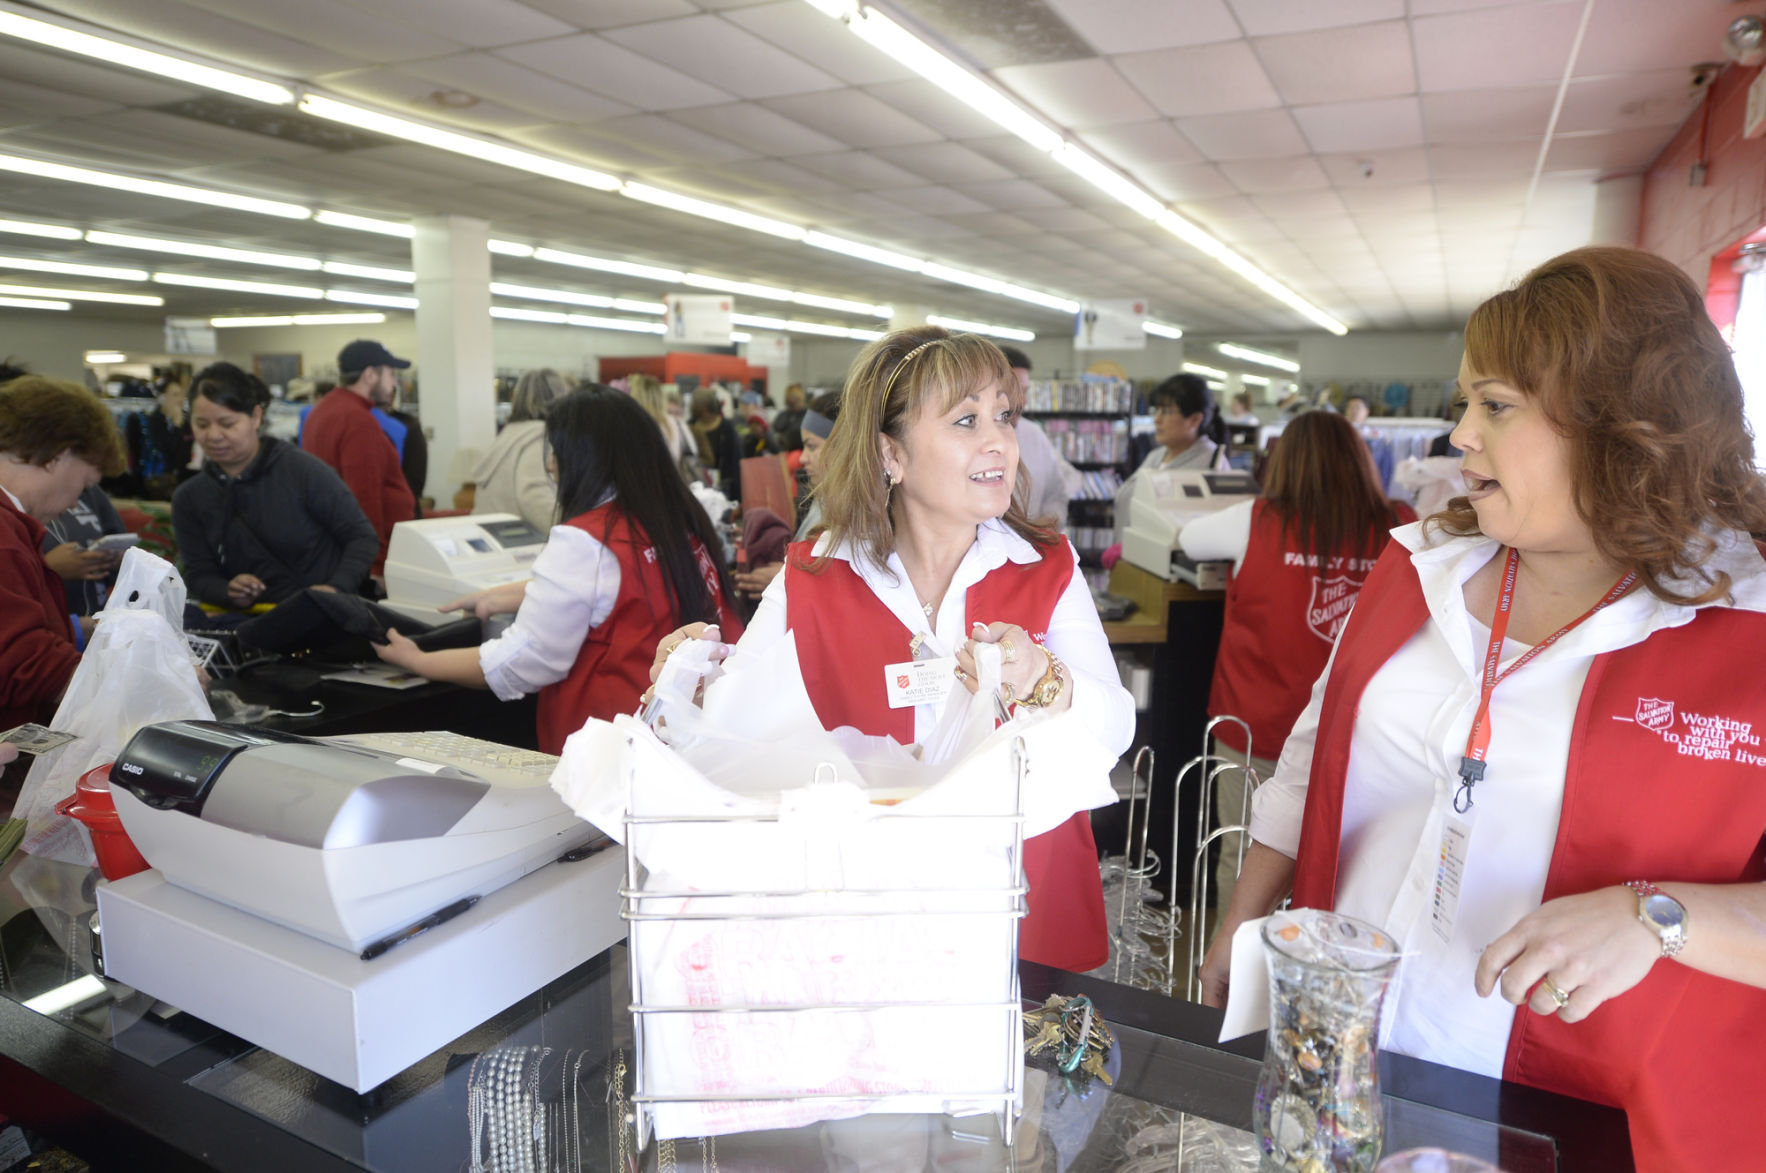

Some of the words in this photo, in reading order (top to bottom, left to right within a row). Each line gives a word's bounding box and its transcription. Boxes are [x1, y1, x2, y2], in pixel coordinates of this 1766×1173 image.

[1284, 552, 1343, 569] FAMY
[1323, 582, 1347, 604] THE
[1500, 594, 1511, 612] ARMY
[1490, 641, 1501, 653] THE
[1638, 705, 1671, 721] SALVATION
[1643, 702, 1659, 711] THE
[1649, 712, 1670, 727] ARMY
[1680, 712, 1752, 734] Working
[1663, 730, 1680, 743] to
[1684, 734, 1731, 750] repair
[1690, 726, 1726, 740] with
[1730, 731, 1761, 746] you
[1677, 741, 1732, 761] broken
[1735, 748, 1766, 767] live
[122, 763, 144, 775] CASIO
